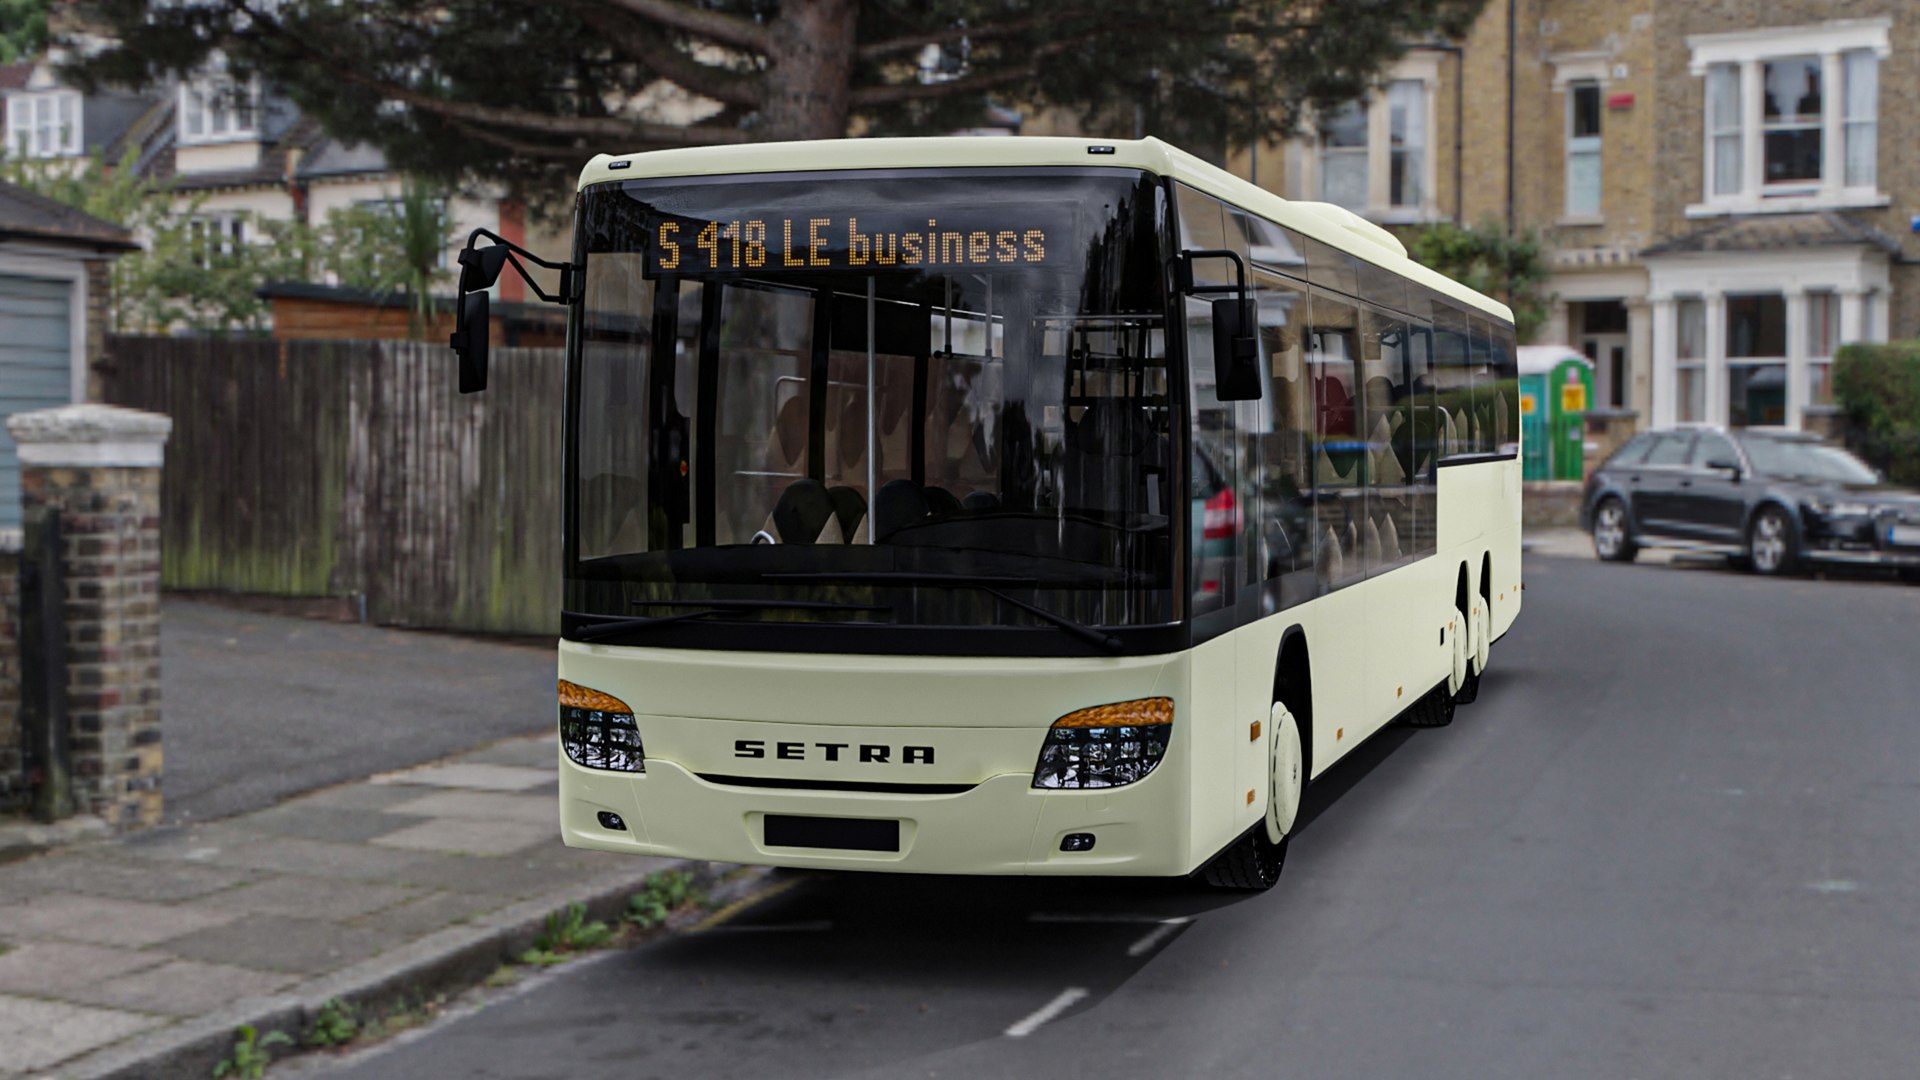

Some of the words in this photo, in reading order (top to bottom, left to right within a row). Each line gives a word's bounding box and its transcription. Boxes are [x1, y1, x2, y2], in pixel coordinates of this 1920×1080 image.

[659, 222, 679, 269] S
[697, 220, 766, 269] 418
[783, 218, 831, 267] LE
[849, 217, 1045, 266] business
[734, 740, 935, 765] SETRA
